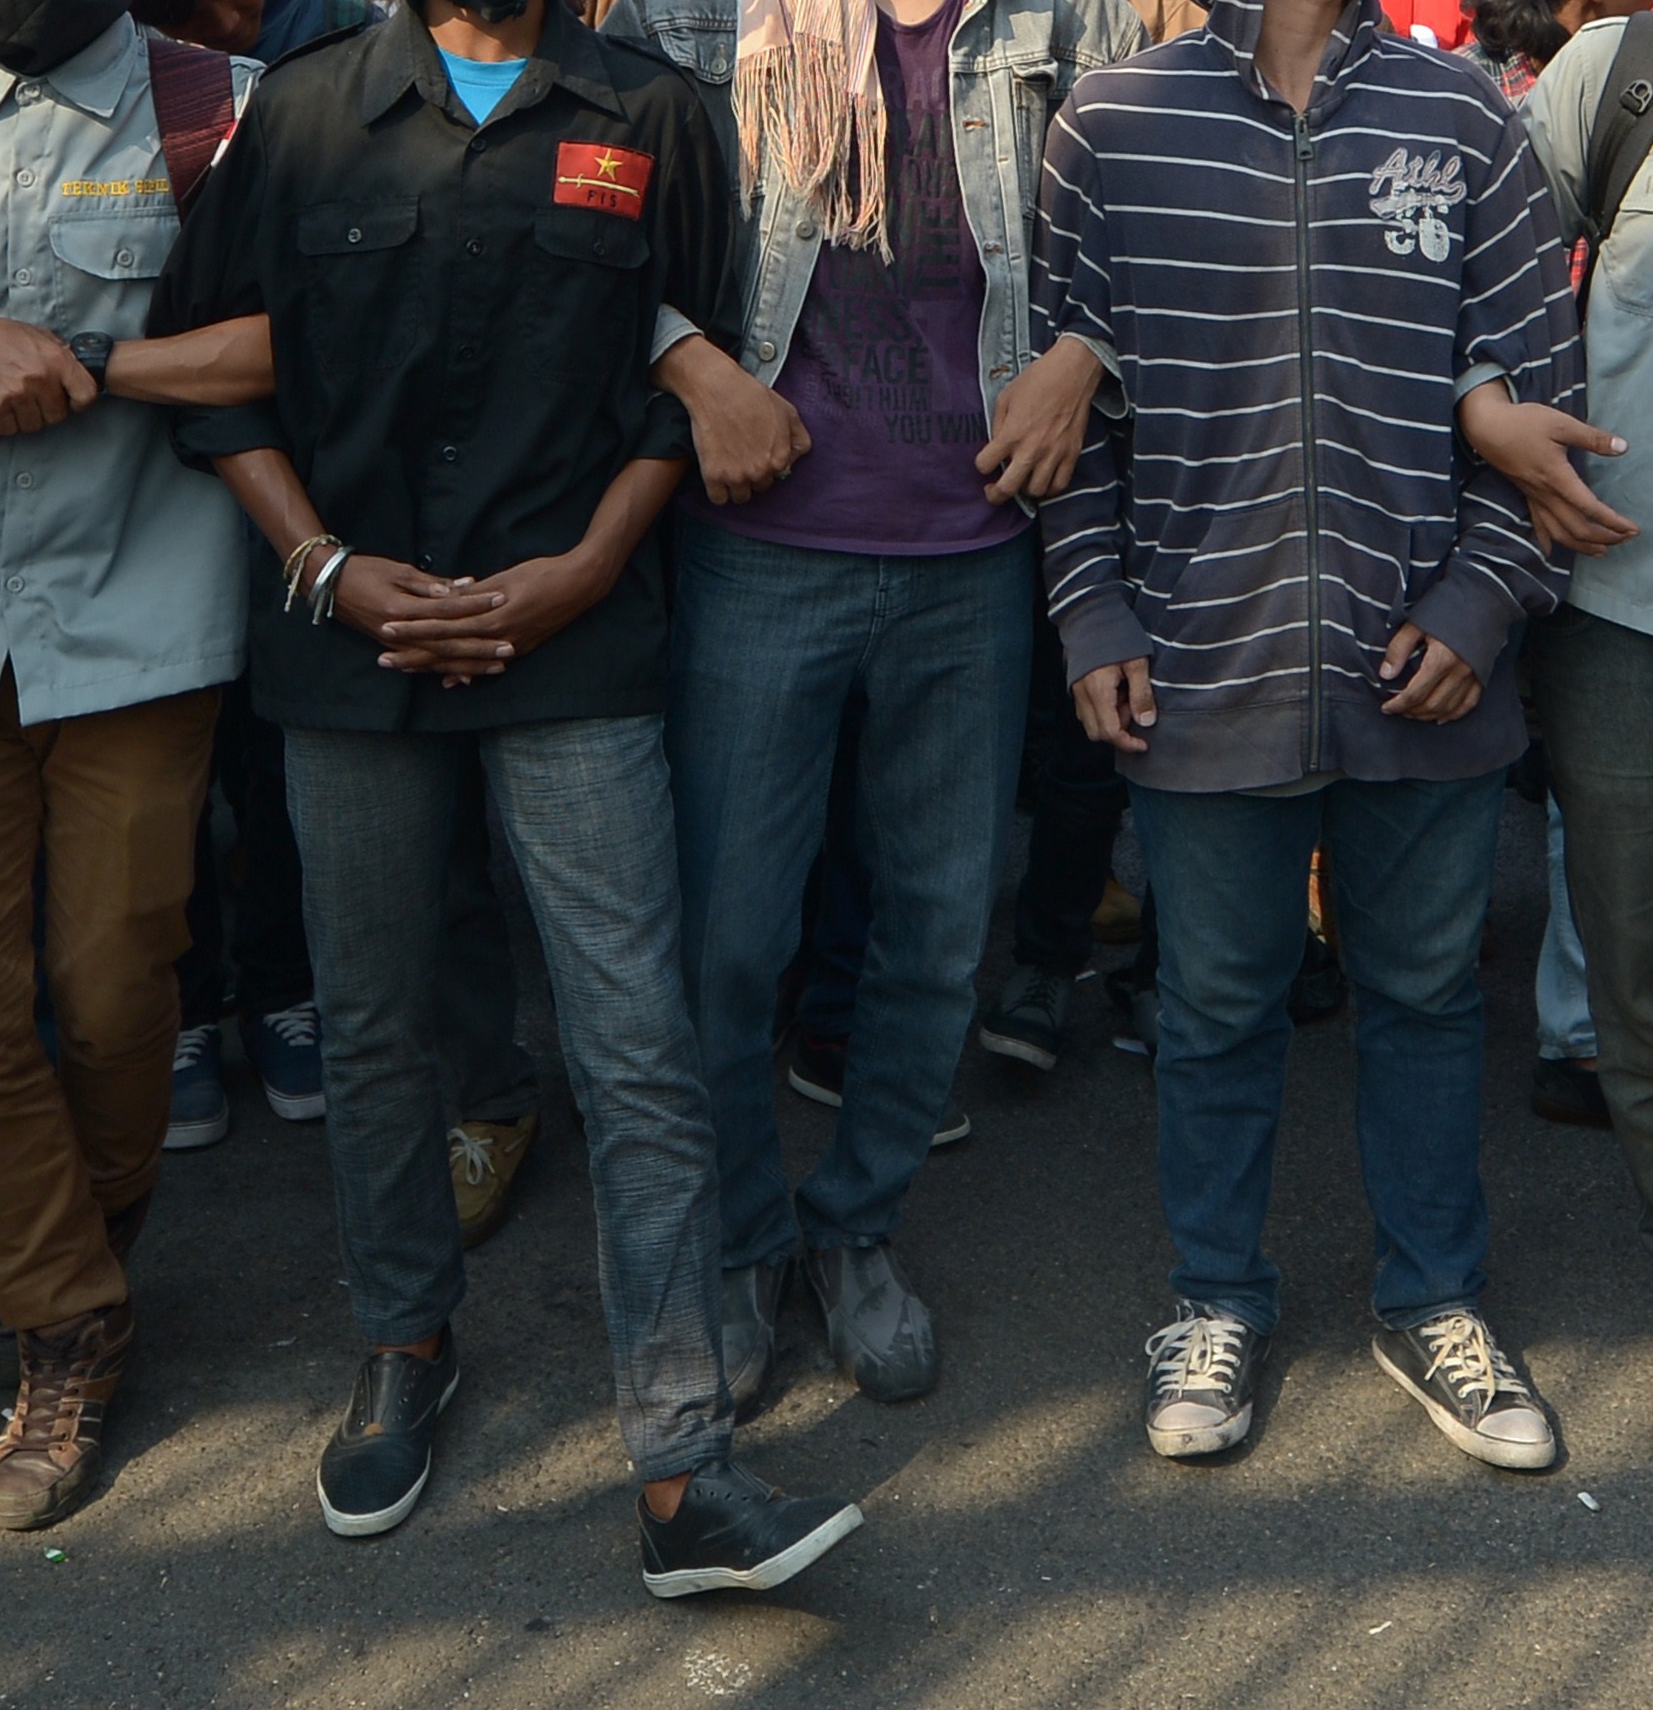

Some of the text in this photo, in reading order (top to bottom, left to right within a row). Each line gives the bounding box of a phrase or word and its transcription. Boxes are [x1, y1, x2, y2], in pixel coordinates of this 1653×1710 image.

[61, 179, 130, 197] TEKNIK
[844, 343, 931, 386] FACE
[885, 413, 932, 444] YOU
